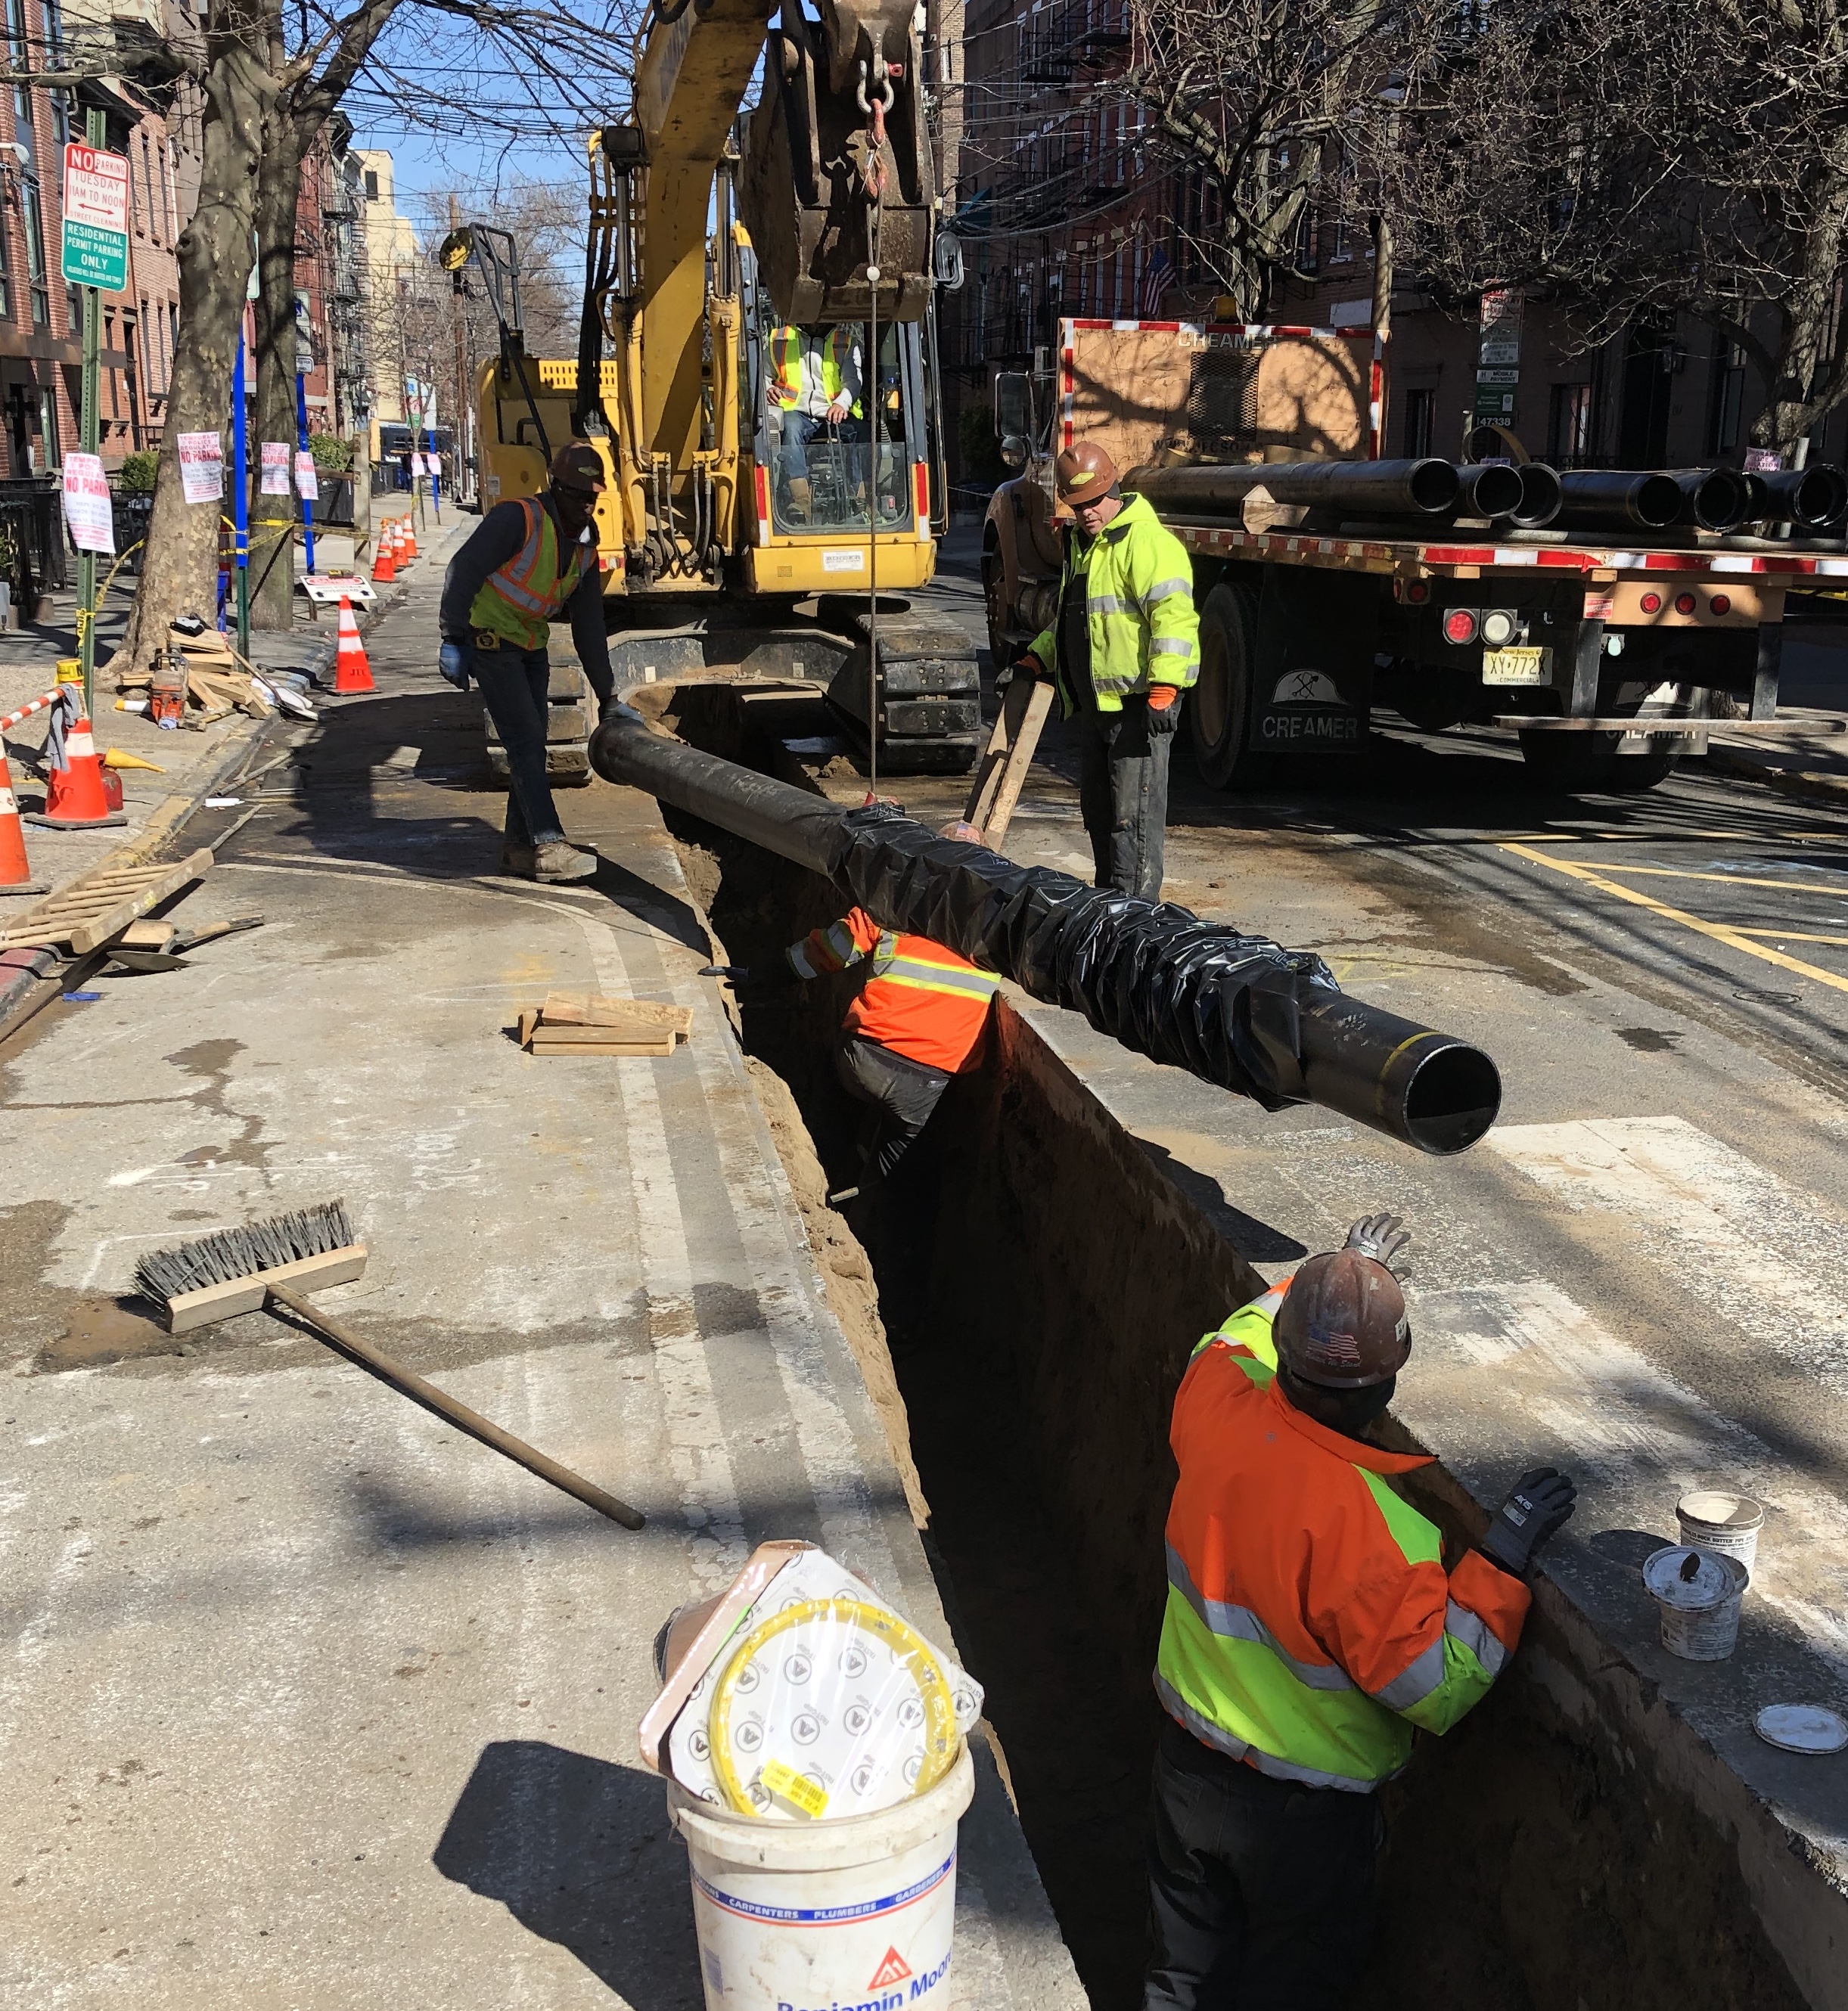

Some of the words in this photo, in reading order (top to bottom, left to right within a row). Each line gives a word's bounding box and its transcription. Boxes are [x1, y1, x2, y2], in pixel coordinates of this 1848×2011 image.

[71, 147, 94, 171] NO
[96, 158, 125, 175] PARKING
[75, 170, 120, 191] TUESDAY
[69, 185, 86, 198] 11AM
[89, 190, 99, 202] TO
[101, 194, 125, 209] NOON
[70, 210, 91, 221] STREET
[93, 216, 123, 229] CLEANING
[67, 223, 123, 247] RESIDENTIAL
[67, 236, 92, 251] PERMIT
[93, 242, 123, 259] PARKING
[80, 253, 108, 270] ONLY
[1178, 332, 1277, 350] CREAMER
[181, 451, 191, 464] NO
[66, 476, 79, 493] NO
[1263, 715, 1358, 739] CREAMER
[728, 1898, 799, 1919] CARPENTERS
[813, 1902, 877, 1920] PLUMBERS
[895, 1867, 944, 1902] GARDENERS
